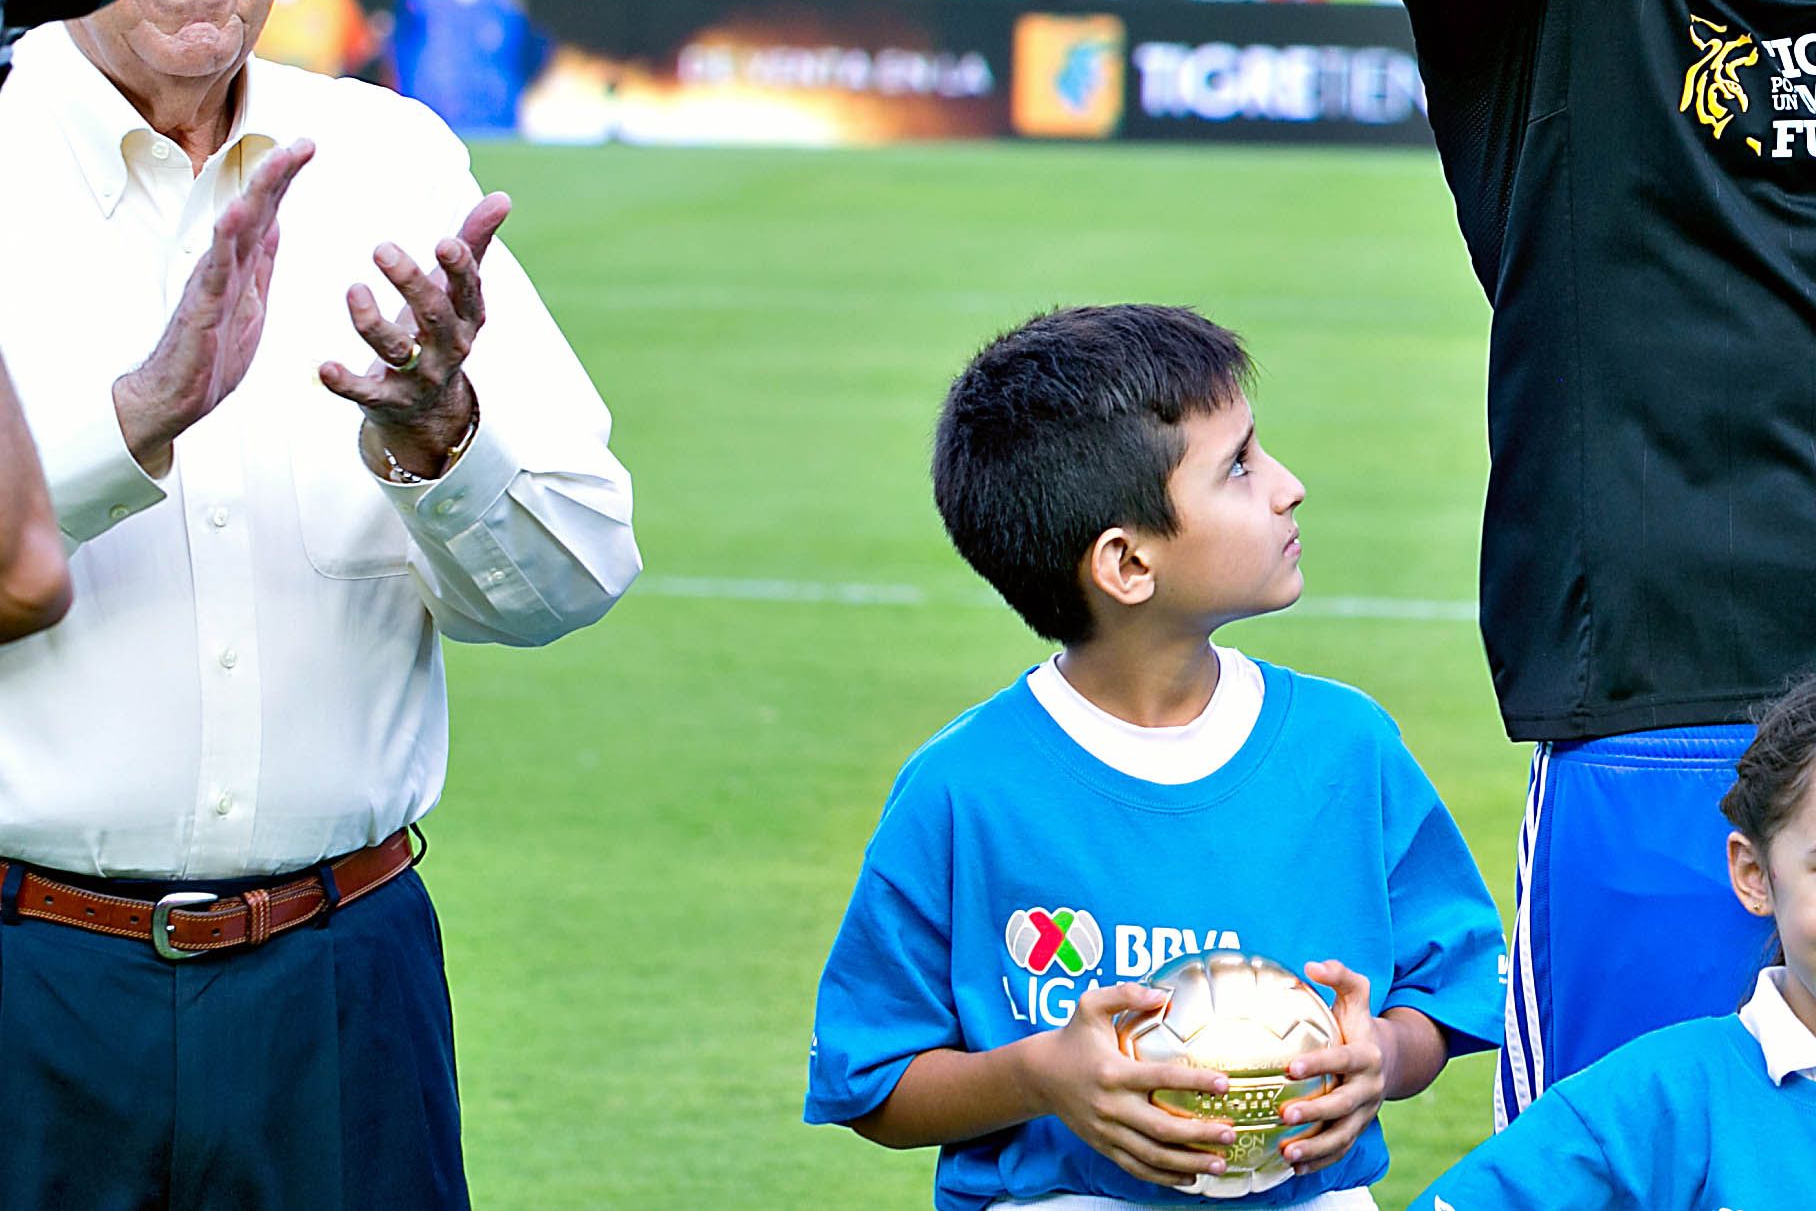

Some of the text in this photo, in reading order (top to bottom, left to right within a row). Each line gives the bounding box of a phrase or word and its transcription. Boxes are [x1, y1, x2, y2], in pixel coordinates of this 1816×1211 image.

[1770, 76, 1798, 93] PO
[1771, 93, 1799, 111] UN
[1002, 976, 1101, 1026] LIG
